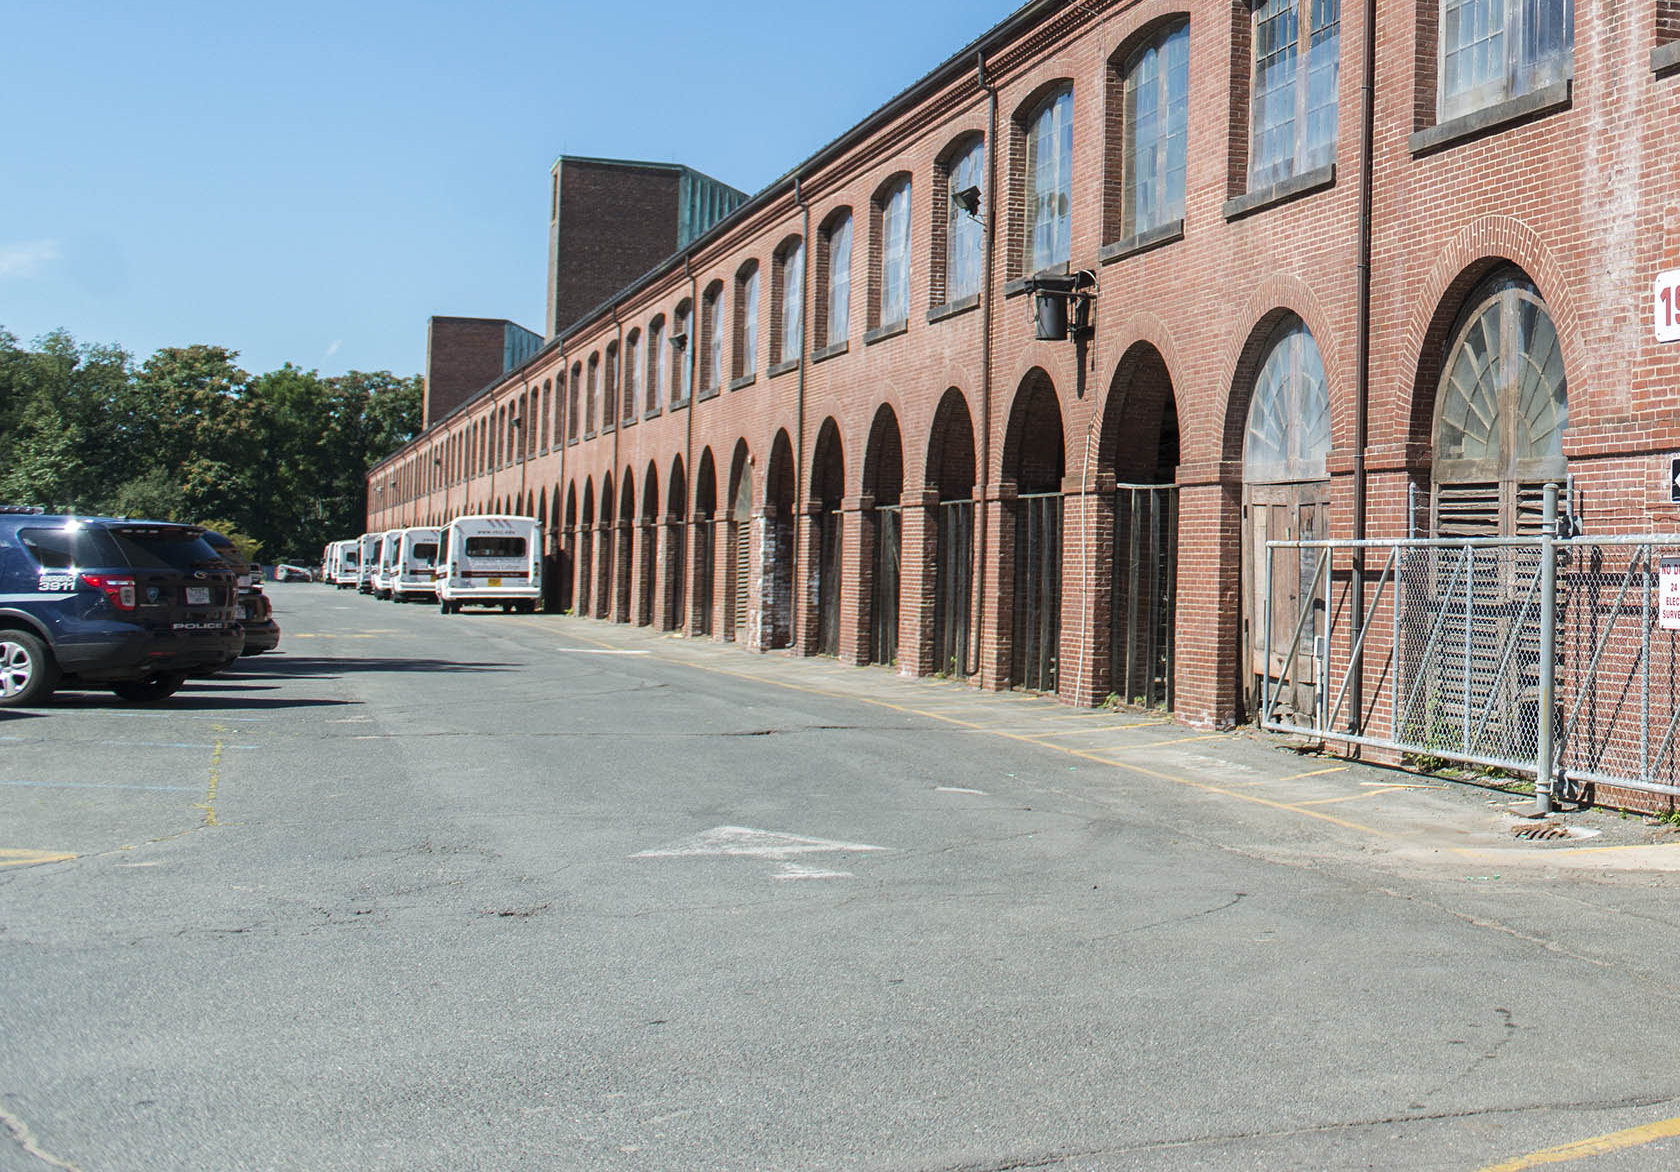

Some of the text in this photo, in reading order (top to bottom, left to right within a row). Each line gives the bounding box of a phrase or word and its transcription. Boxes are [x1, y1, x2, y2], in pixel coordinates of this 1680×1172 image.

[1661, 563, 1671, 575] NO
[38, 581, 76, 591] 3911
[1670, 582, 1678, 592] 24
[172, 622, 223, 630] POLICE
